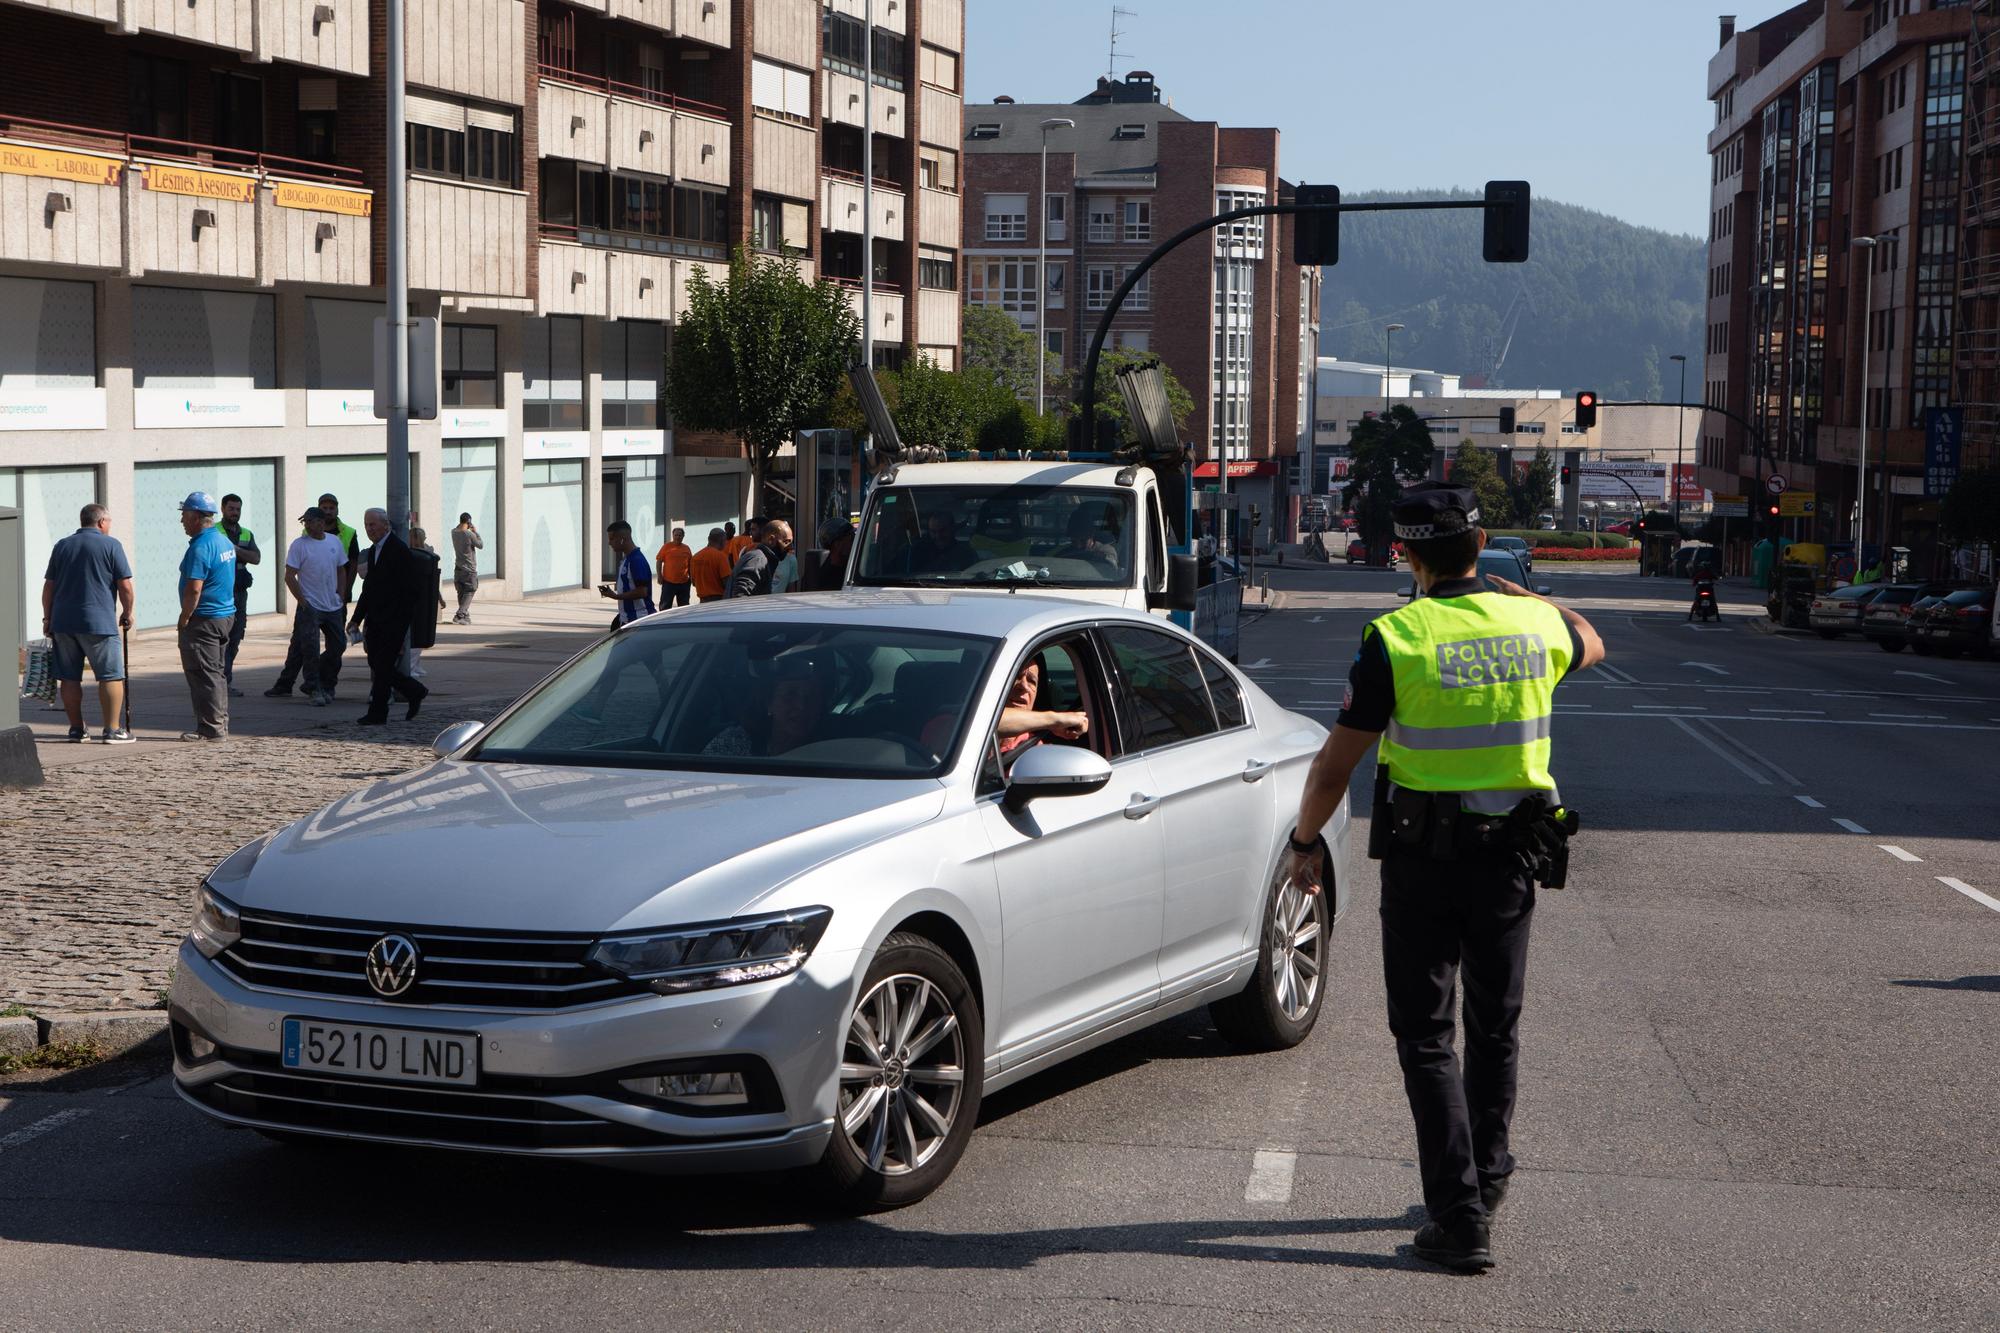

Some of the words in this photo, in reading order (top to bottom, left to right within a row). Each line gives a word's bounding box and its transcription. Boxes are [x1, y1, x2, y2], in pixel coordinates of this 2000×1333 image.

[3, 151, 38, 169] FISCAL
[55, 158, 101, 177] LABORAL
[154, 168, 195, 193] Lesmes
[196, 174, 241, 198] Asesores
[282, 189, 320, 205] ABOGADO
[325, 194, 362, 210] CONTABLE
[1228, 465, 1257, 474] APFRE
[1444, 639, 1540, 665] POLICIA
[1457, 660, 1533, 685] LOCAL
[288, 1047, 296, 1060] E
[307, 1026, 388, 1071] 5210
[400, 1036, 465, 1079] LND
